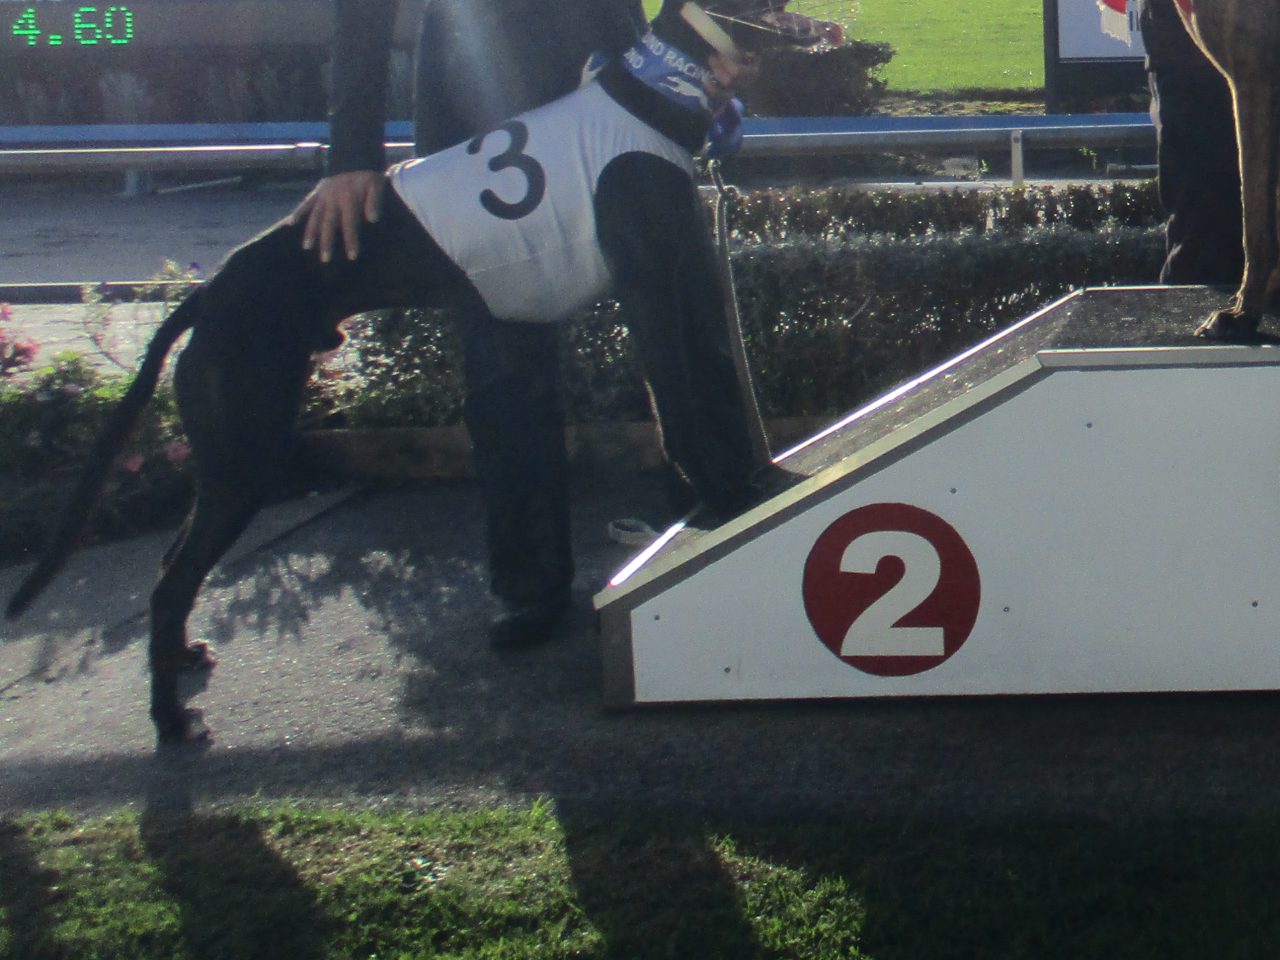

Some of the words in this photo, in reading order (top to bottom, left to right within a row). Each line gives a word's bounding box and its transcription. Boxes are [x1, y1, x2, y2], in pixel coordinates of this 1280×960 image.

[12, 6, 134, 46] 4.60
[467, 120, 546, 220] 3
[838, 530, 945, 657] 2
